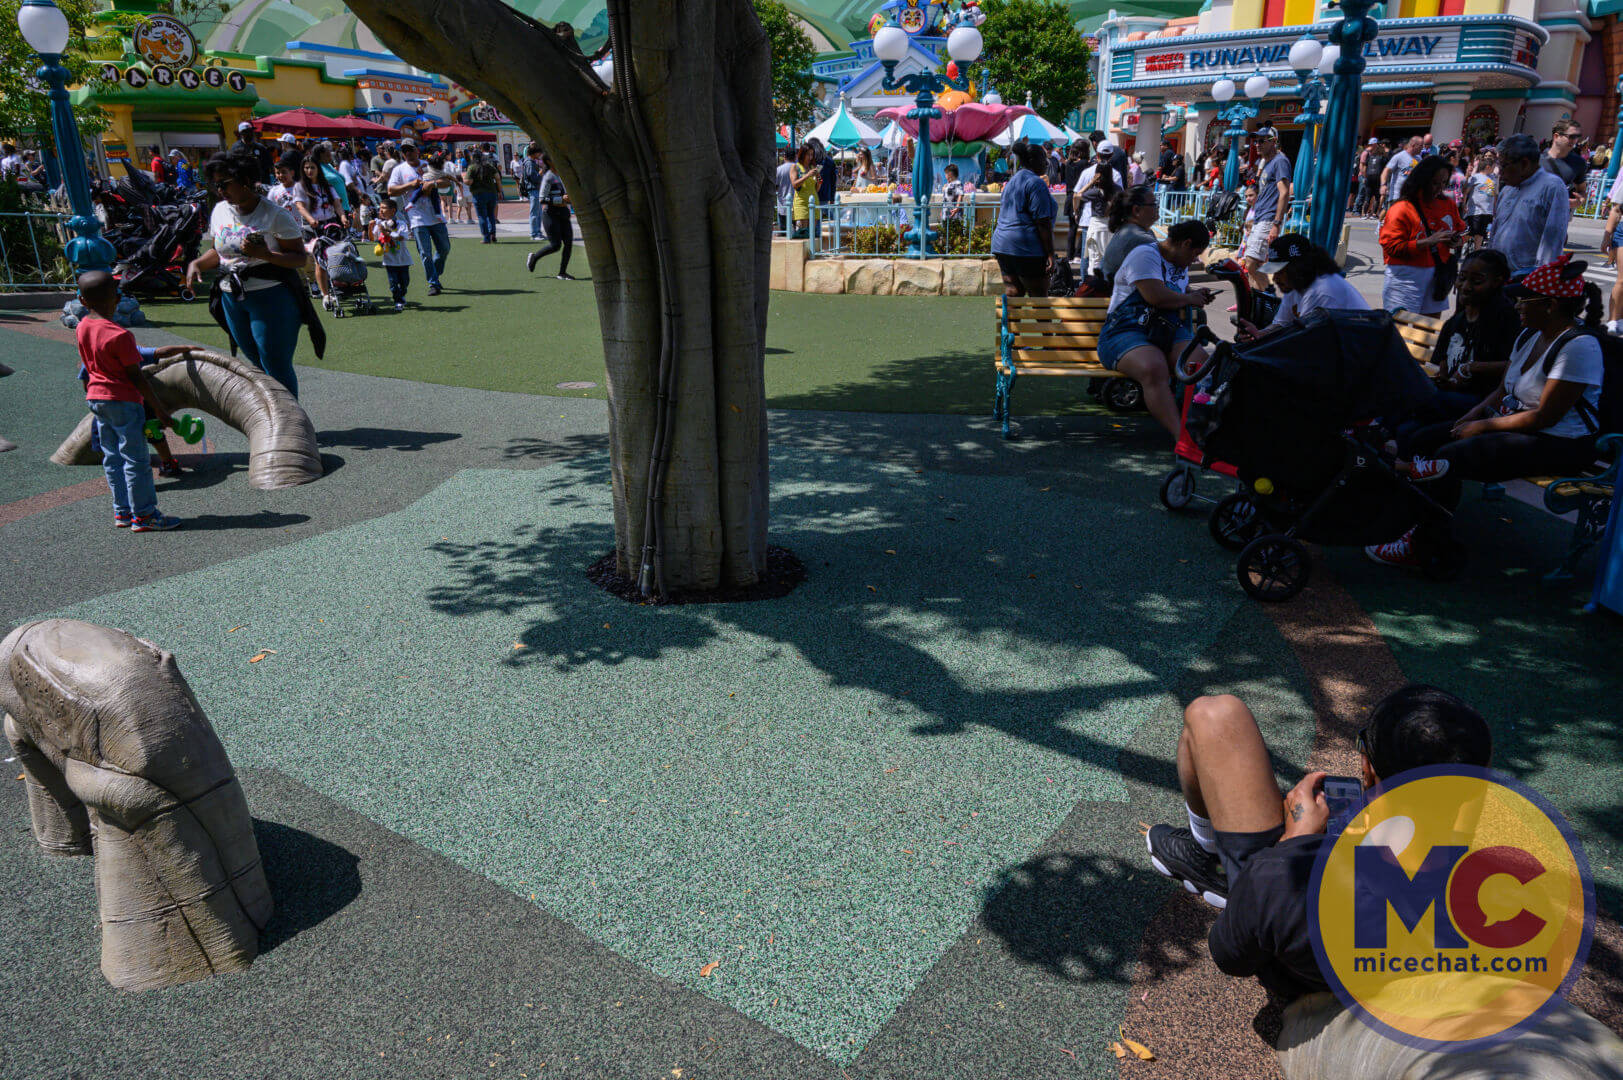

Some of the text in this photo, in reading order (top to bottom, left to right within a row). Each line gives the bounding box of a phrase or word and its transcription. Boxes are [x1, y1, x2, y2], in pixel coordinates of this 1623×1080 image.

[141, 20, 164, 37] GOD
[1189, 35, 1442, 69] RUNAWA LWAY
[101, 66, 243, 90] MARKET
